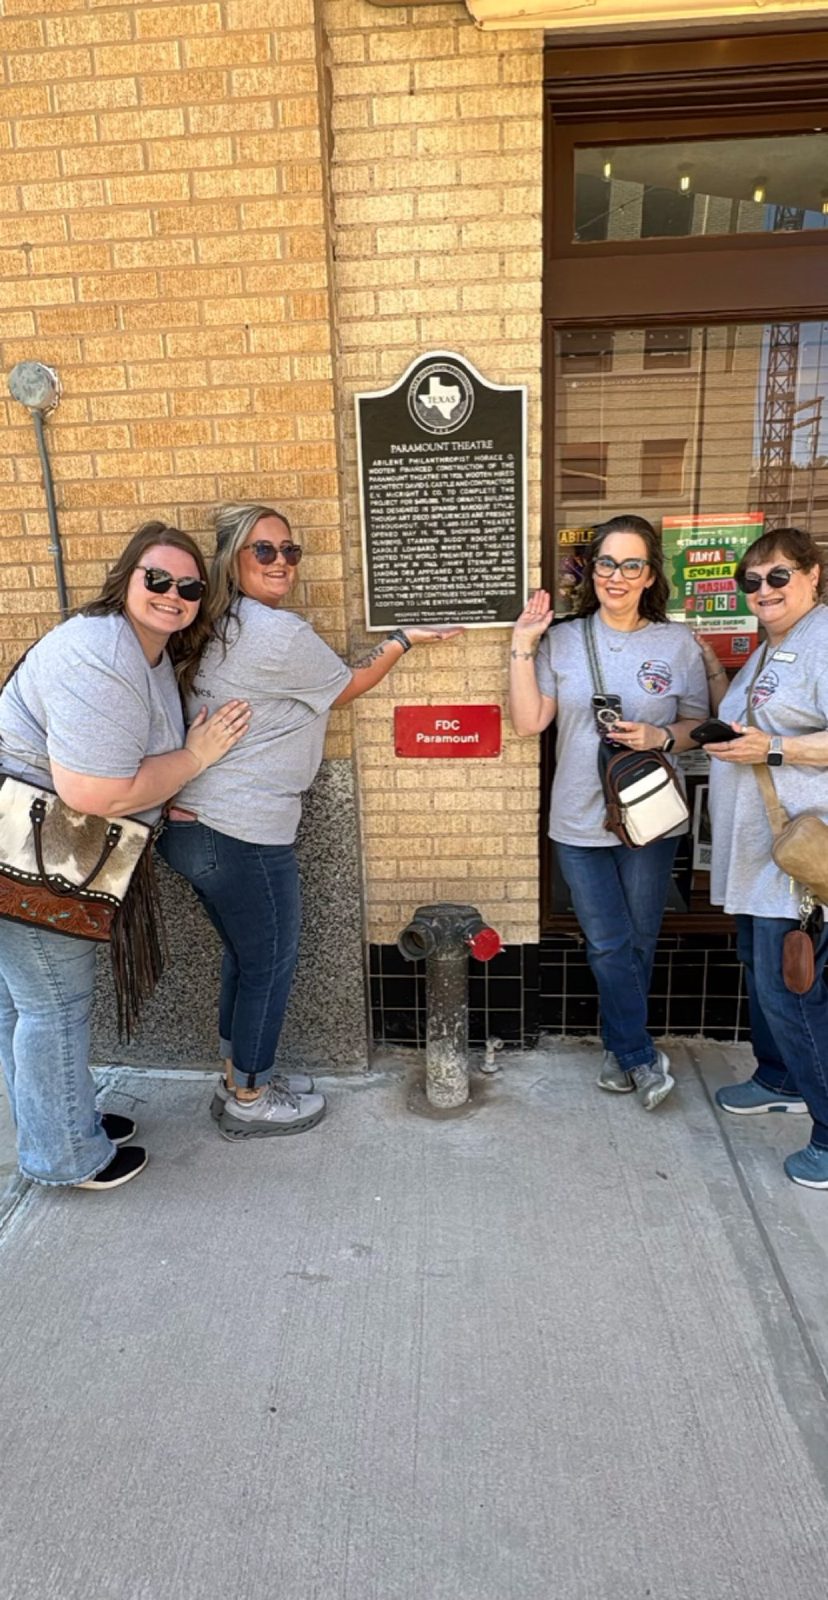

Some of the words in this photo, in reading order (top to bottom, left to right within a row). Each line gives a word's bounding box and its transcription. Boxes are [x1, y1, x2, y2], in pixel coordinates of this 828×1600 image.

[428, 396, 455, 404] TEXAS
[390, 441, 449, 454] PARAMOUNT
[451, 439, 494, 450] THEATRE
[409, 456, 470, 464] PHILANTHROPIST
[436, 463, 484, 471] CONSTRUCTION
[470, 478, 514, 486] CONTRACTORS
[689, 551, 721, 562] VANYA
[688, 565, 731, 578] SONIA
[697, 581, 734, 593] MASHA
[435, 720, 460, 730] FDC
[416, 732, 479, 743] Paramount
